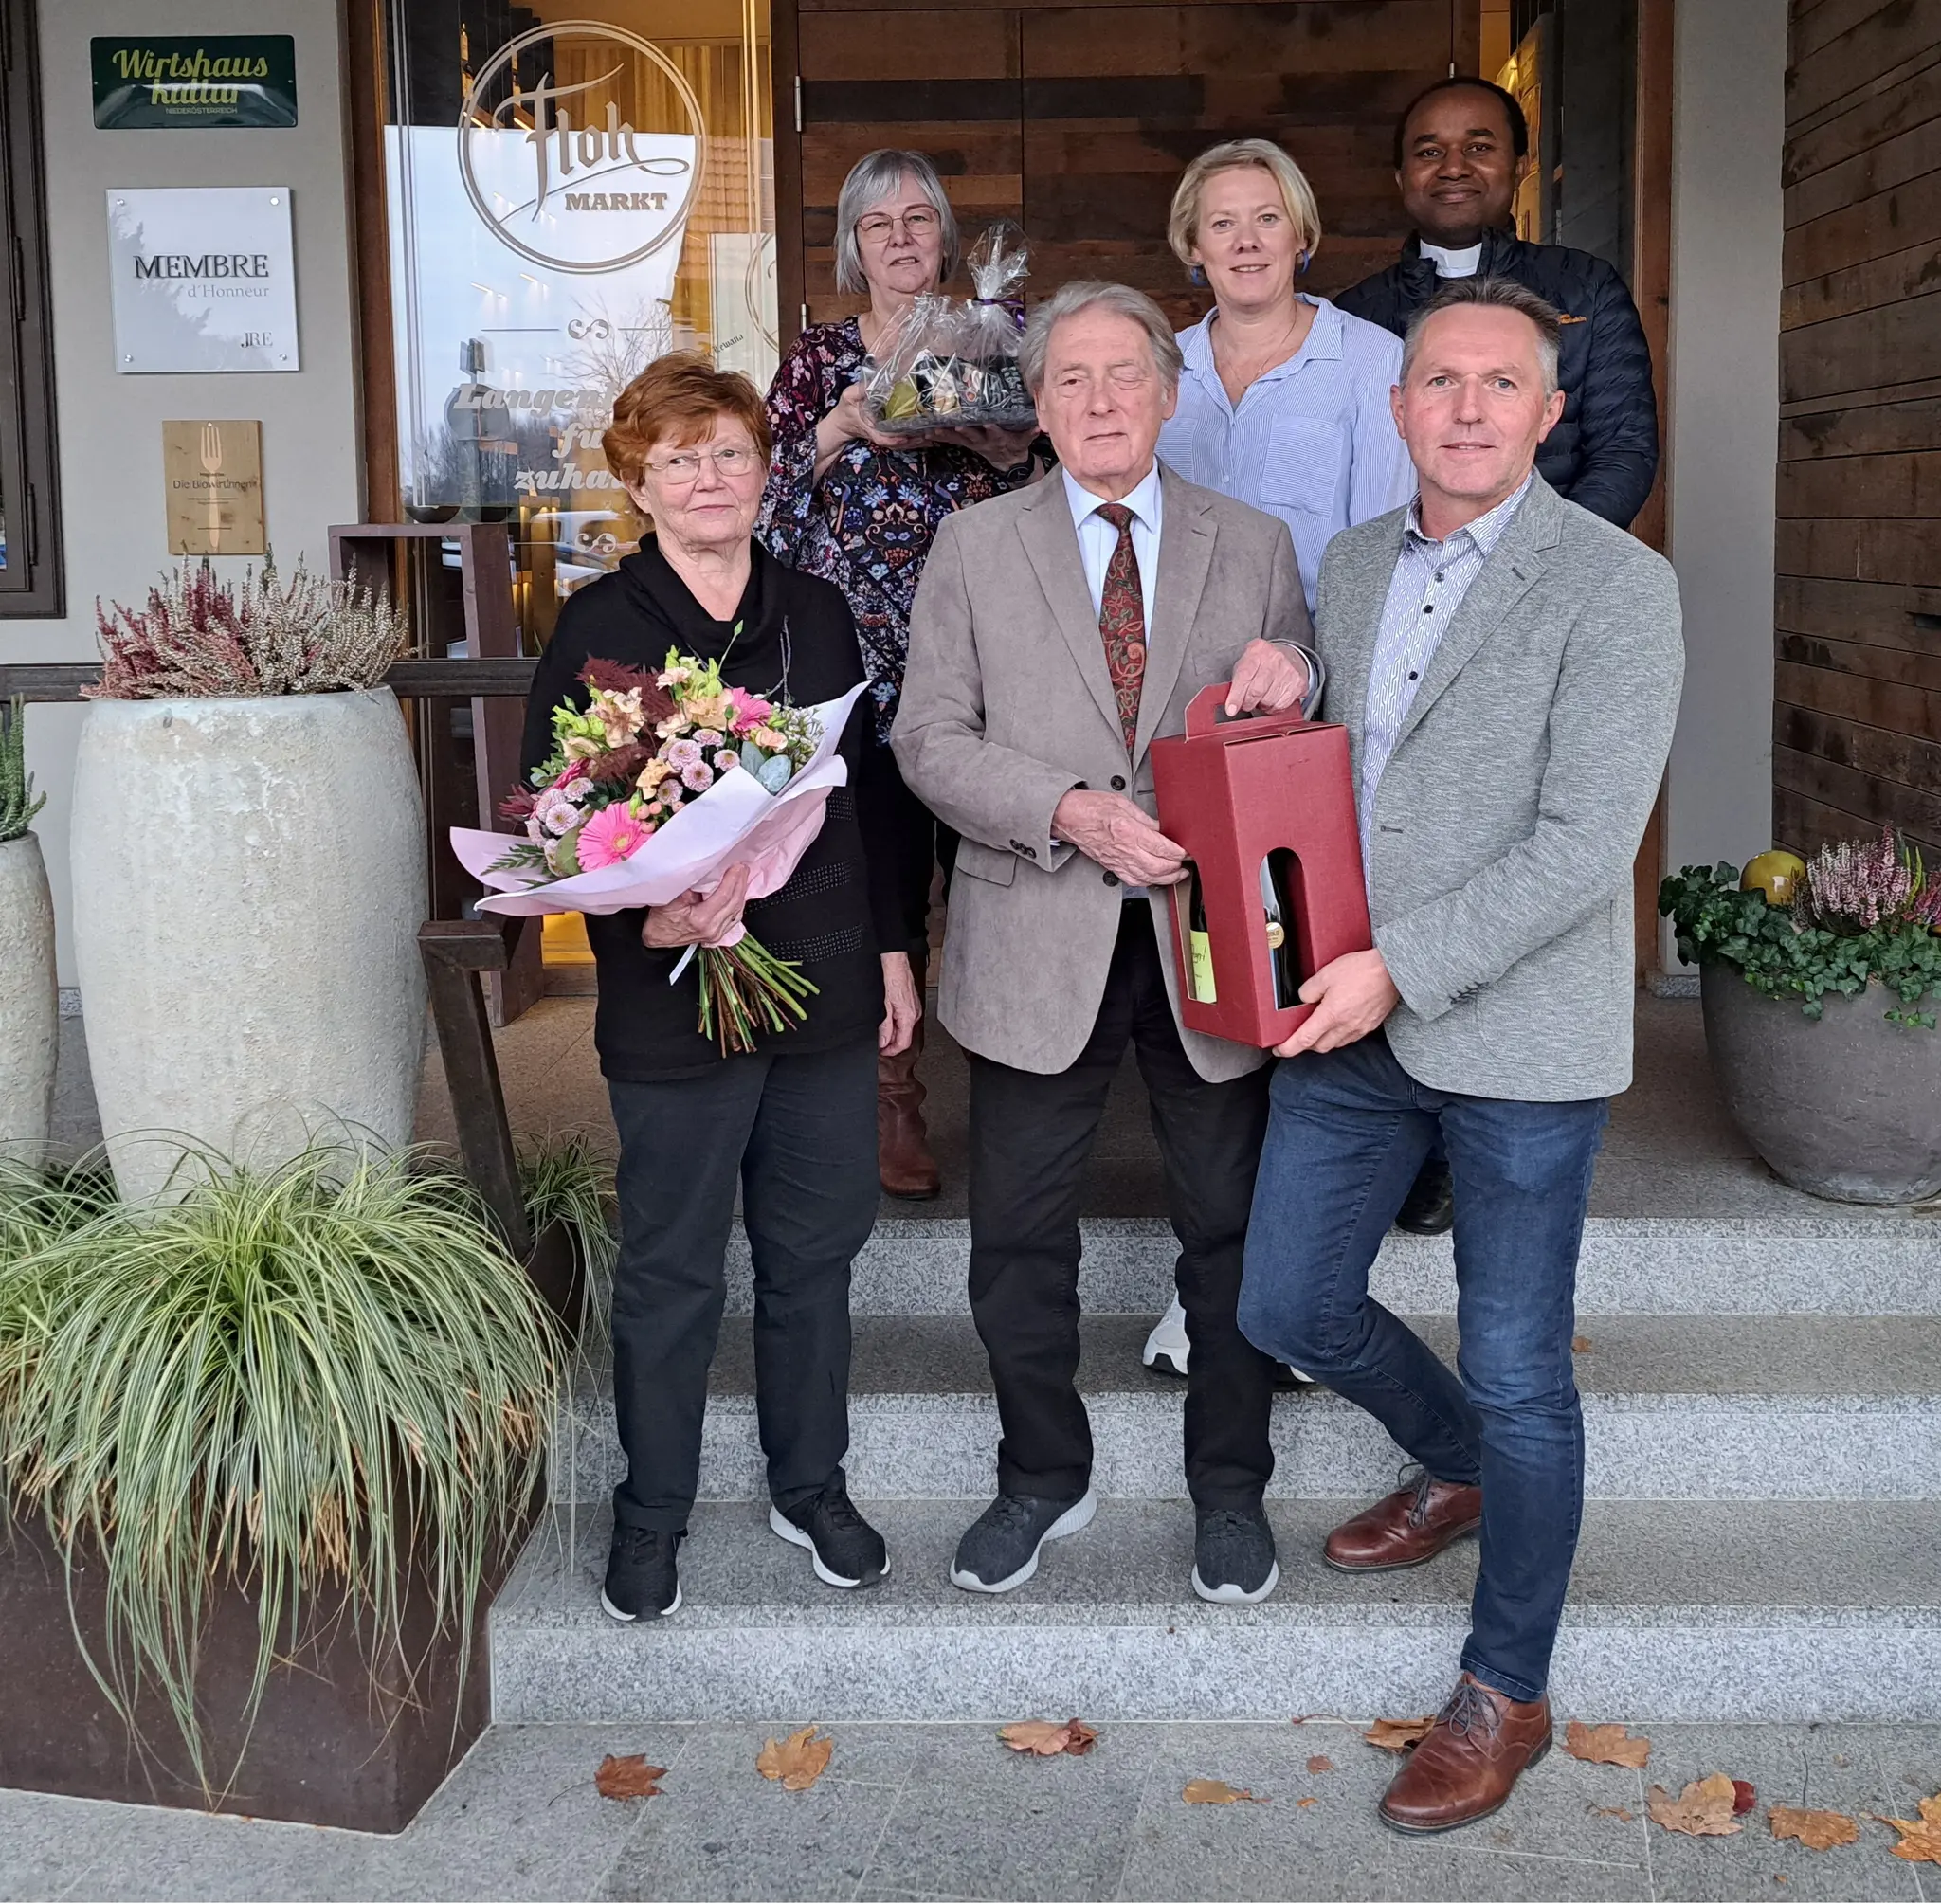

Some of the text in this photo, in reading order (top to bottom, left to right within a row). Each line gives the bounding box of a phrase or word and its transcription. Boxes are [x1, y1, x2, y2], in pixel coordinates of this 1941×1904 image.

[112, 49, 268, 78] Wirtshaus
[165, 106, 238, 115] NIEDERÖSTERREICH
[565, 192, 668, 211] MARKT
[134, 254, 269, 279] MEMBRE
[241, 332, 273, 348] JRE
[453, 372, 617, 418] Langenl
[552, 422, 606, 459] fü
[172, 480, 190, 489] Die
